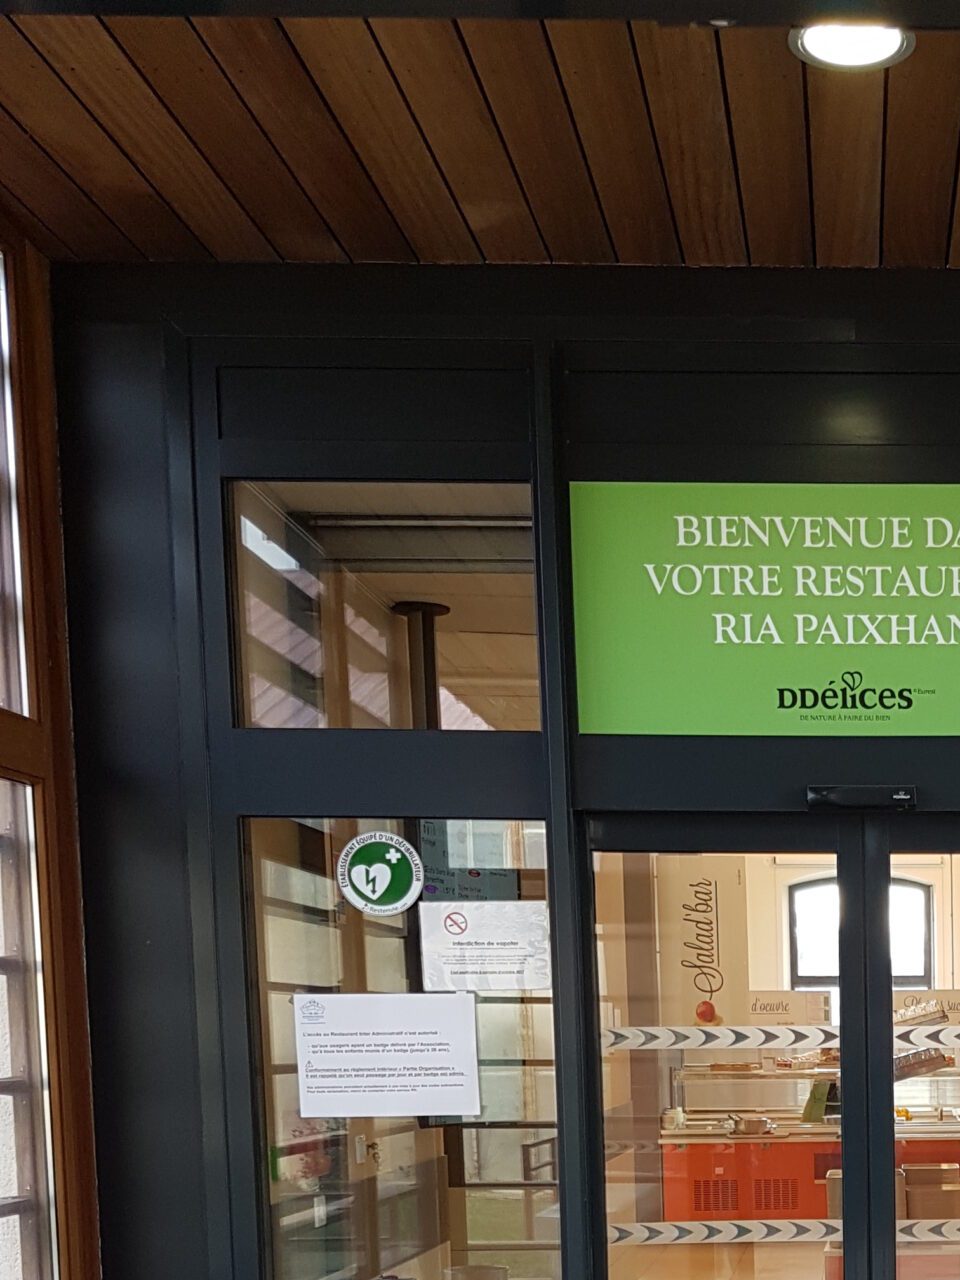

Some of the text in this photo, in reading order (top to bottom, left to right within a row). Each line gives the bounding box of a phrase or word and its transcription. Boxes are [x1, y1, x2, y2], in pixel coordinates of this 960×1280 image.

[673, 514, 913, 548] BIENVENUE
[644, 564, 783, 596] VOTRE
[713, 613, 784, 645] RIA
[838, 713, 843, 721] À
[340, 843, 358, 888] ÉTABLISSEMENT
[356, 833, 377, 845] ÉQUIPÉ
[379, 834, 394, 842] D'UN
[395, 839, 421, 882] DÉFIBRILLATEUR
[681, 877, 724, 1001] Salad'bar
